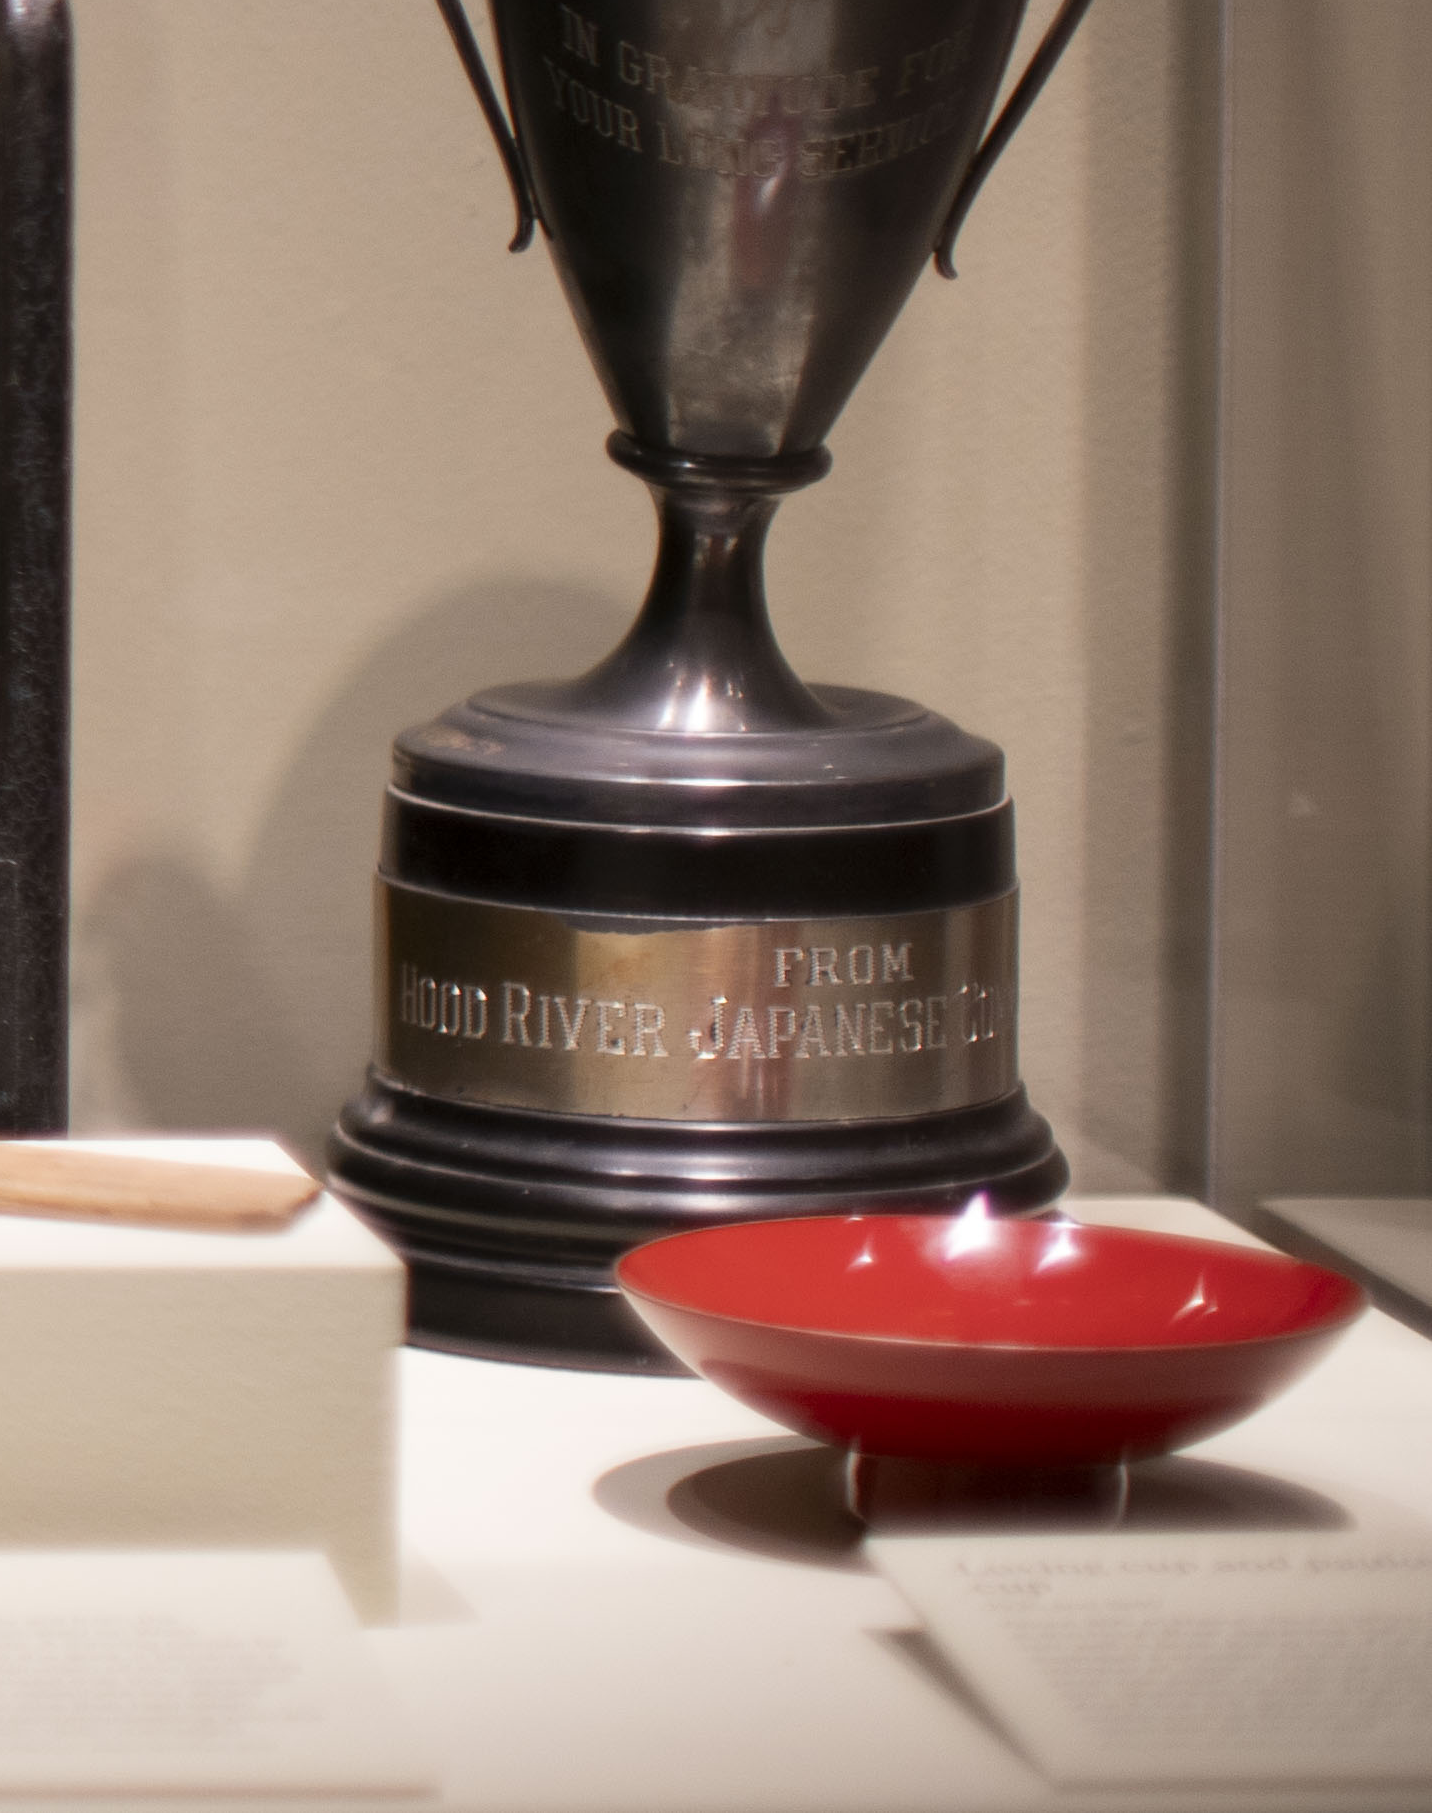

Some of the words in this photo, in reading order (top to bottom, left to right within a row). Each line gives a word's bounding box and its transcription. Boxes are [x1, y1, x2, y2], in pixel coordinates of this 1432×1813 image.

[543, 55, 644, 153] YOUR
[401, 963, 488, 1040] HOOD
[502, 979, 669, 1059] RIVER
[687, 994, 949, 1060] JAPANESE
[775, 942, 915, 989] FROM
